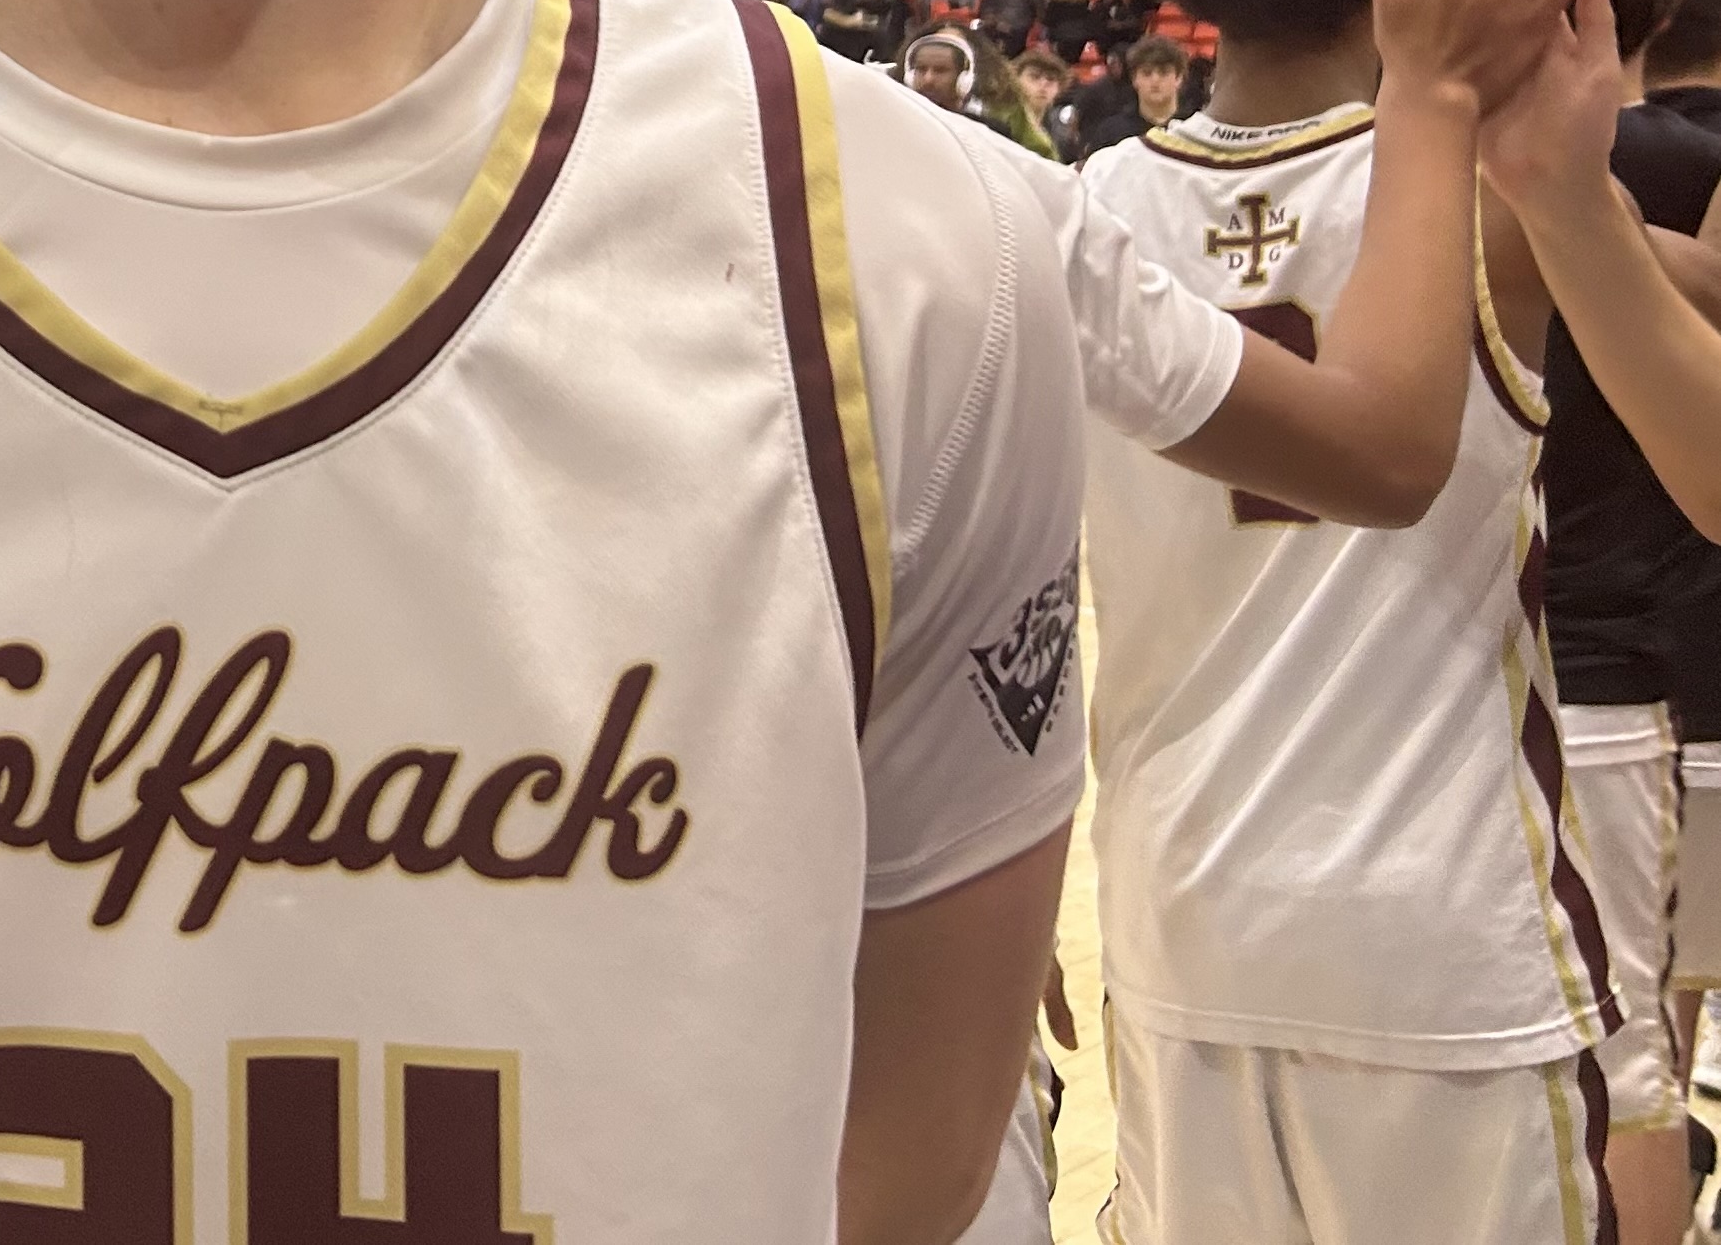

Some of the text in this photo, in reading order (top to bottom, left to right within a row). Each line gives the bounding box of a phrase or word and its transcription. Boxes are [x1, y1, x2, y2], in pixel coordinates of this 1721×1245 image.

[1227, 207, 1286, 231] A M
[1228, 252, 1244, 269] D
